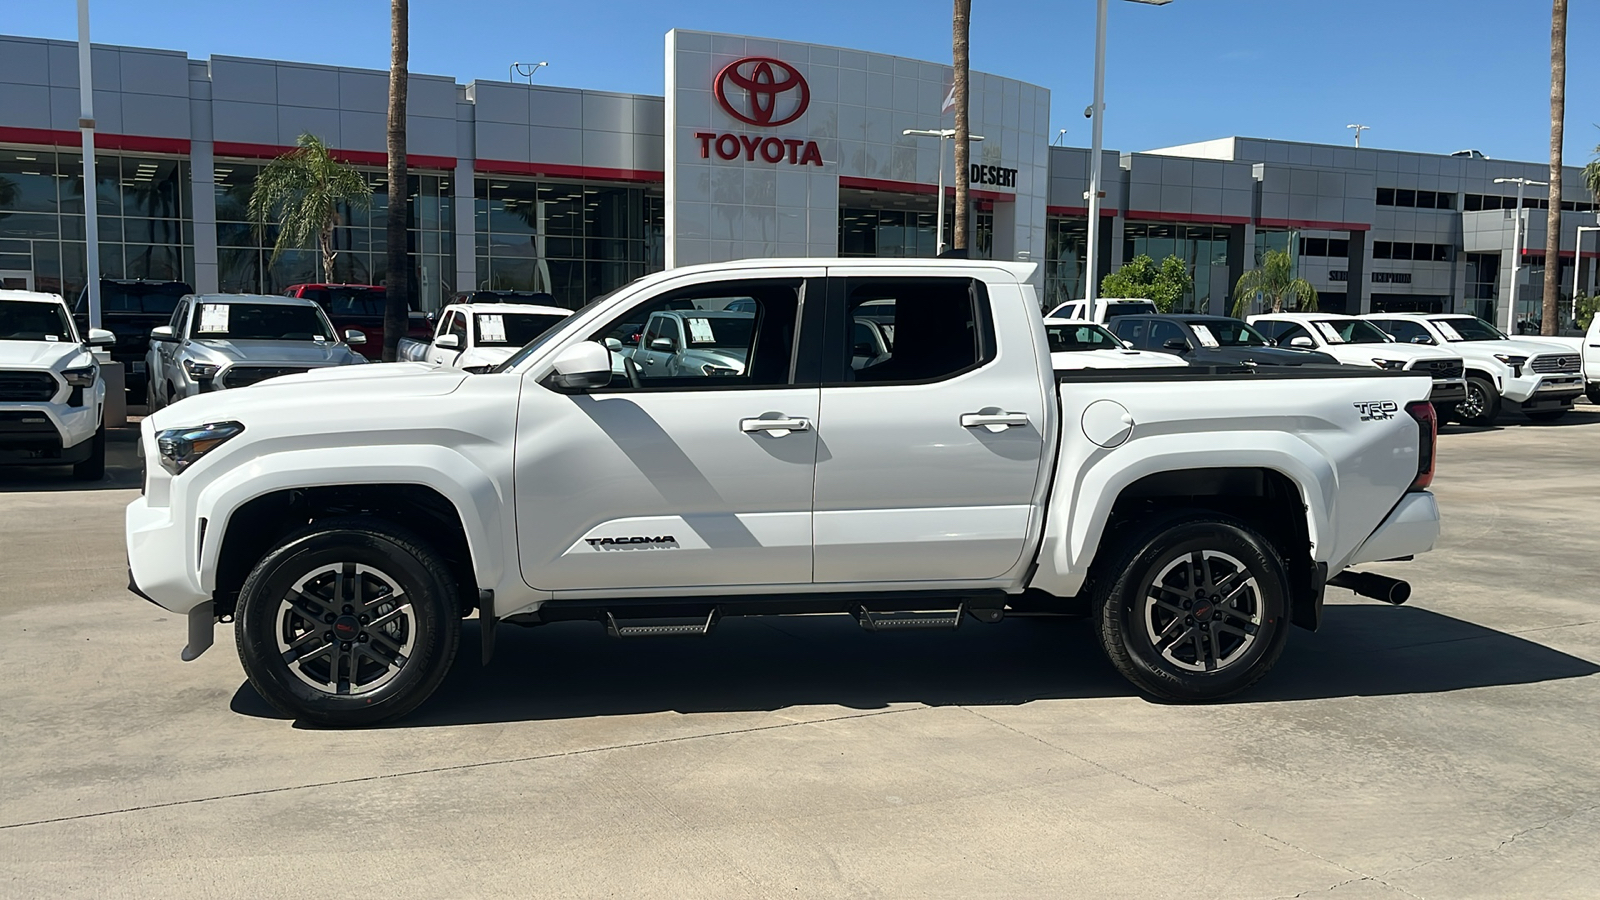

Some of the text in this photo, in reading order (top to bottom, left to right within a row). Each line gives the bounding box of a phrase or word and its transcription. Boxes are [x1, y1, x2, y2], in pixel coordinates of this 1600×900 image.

[694, 132, 823, 166] TOYOTA
[970, 163, 1018, 188] DESERT
[1353, 400, 1398, 418] TRD
[585, 535, 676, 546] TACOMA
